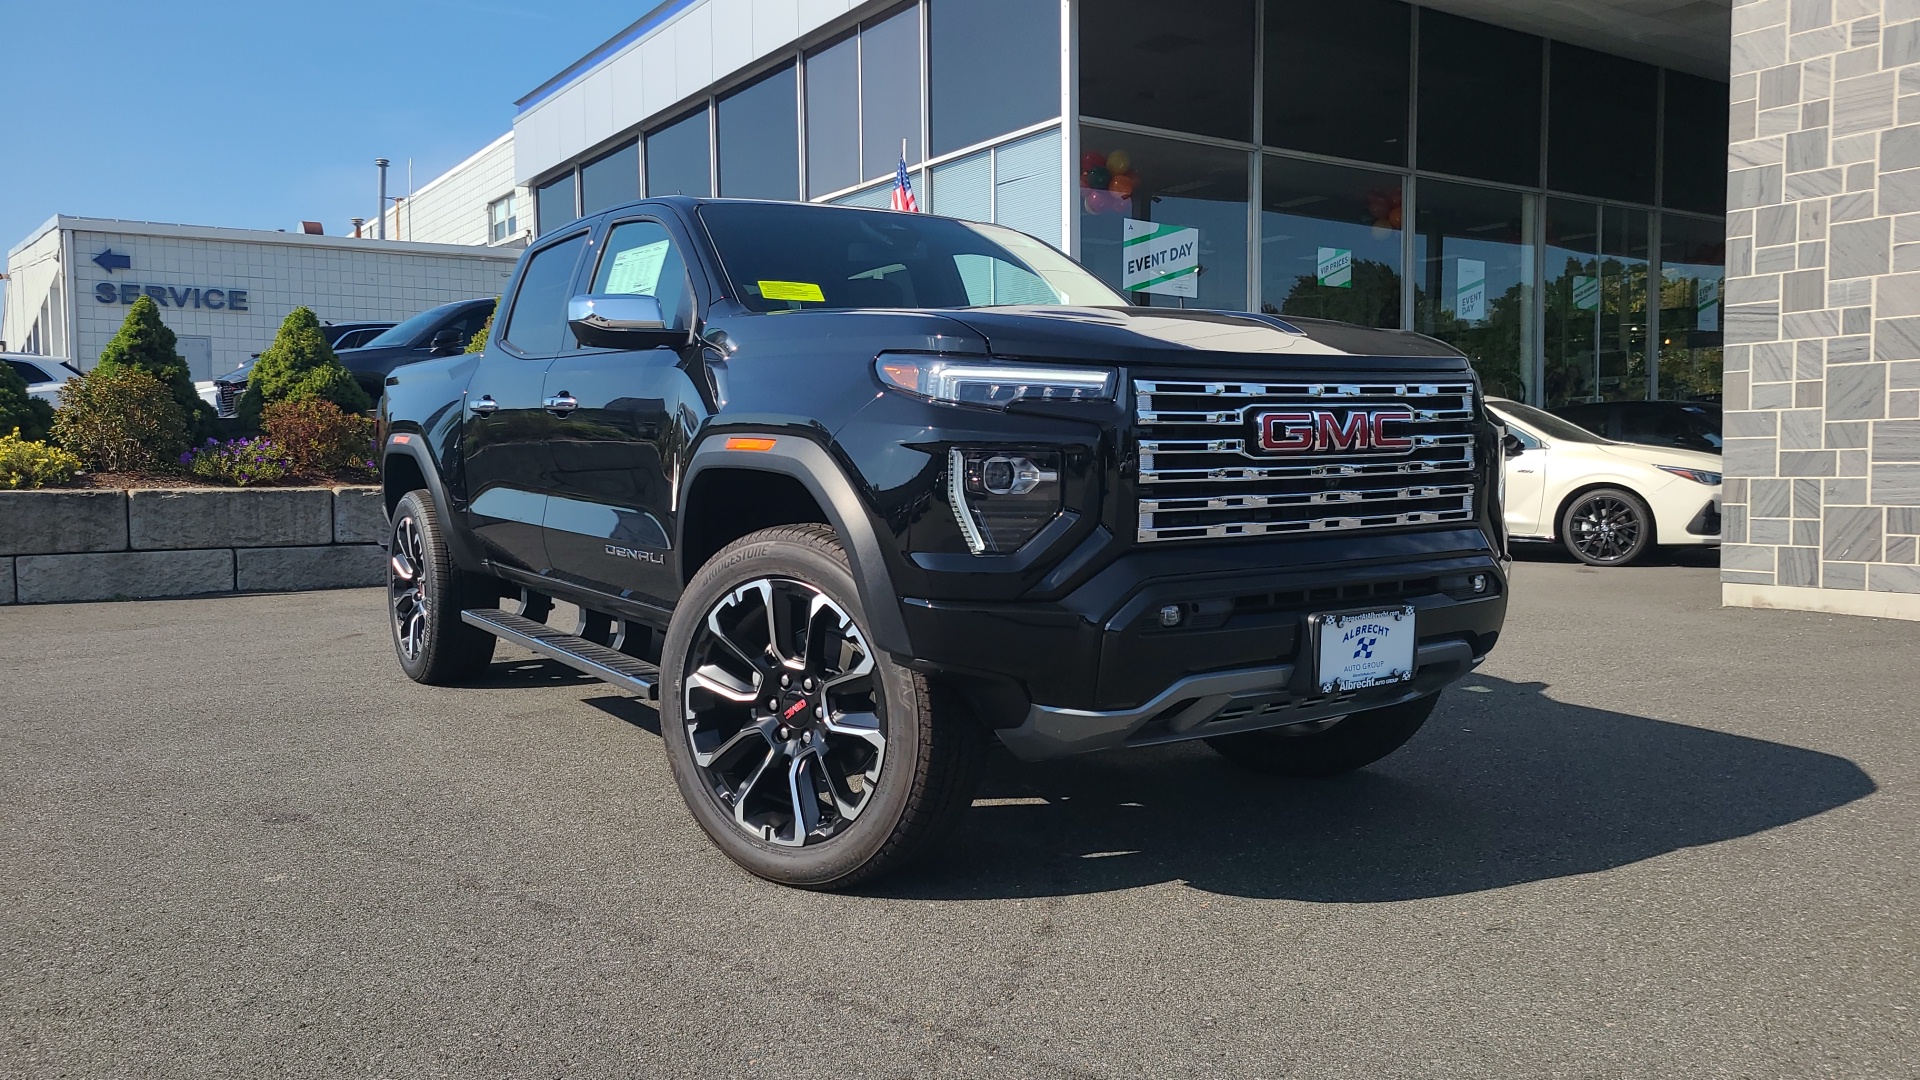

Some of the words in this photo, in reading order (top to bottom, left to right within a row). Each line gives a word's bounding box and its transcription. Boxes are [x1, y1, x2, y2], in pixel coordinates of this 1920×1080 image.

[1127, 249, 1168, 275] EVENT
[1170, 241, 1194, 262] DAY
[1320, 265, 1329, 275] VIP
[1330, 257, 1348, 270] PRICES
[95, 282, 249, 311] SERVICE
[1462, 291, 1482, 307] EVENT
[1461, 303, 1475, 316] DAY
[1256, 410, 1415, 451] GMC
[604, 544, 664, 565] DENALI
[701, 546, 768, 588] BRIDGESTONE
[1342, 624, 1389, 643] ALBRECHT
[1344, 664, 1361, 672] AUTO
[1362, 660, 1384, 670] GROUP
[1339, 677, 1375, 691] Albrecht
[783, 698, 807, 720] GMC
